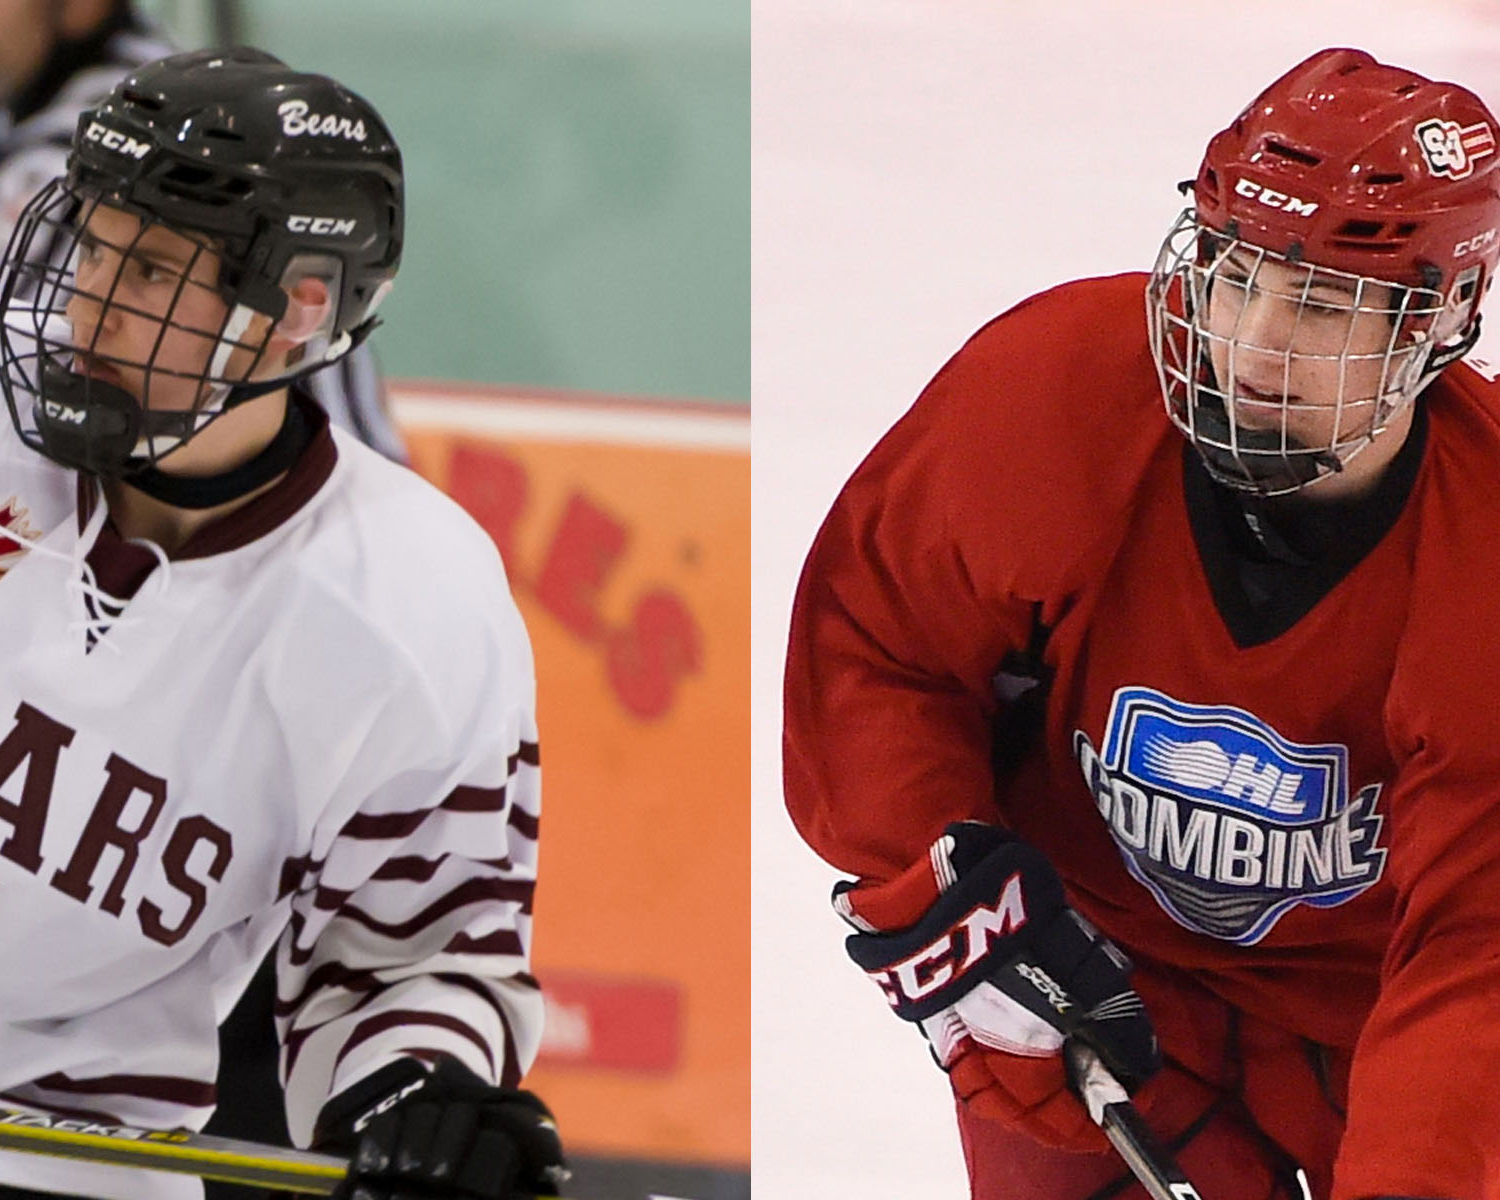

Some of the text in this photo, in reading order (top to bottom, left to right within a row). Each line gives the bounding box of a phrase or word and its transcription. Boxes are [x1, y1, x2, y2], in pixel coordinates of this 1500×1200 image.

[84, 120, 152, 160] CCM
[278, 99, 368, 141] Bears
[1233, 177, 1320, 218] CCM
[286, 213, 359, 236] CCM
[1453, 227, 1498, 259] CCM
[1079, 740, 1372, 890] COMBINE
